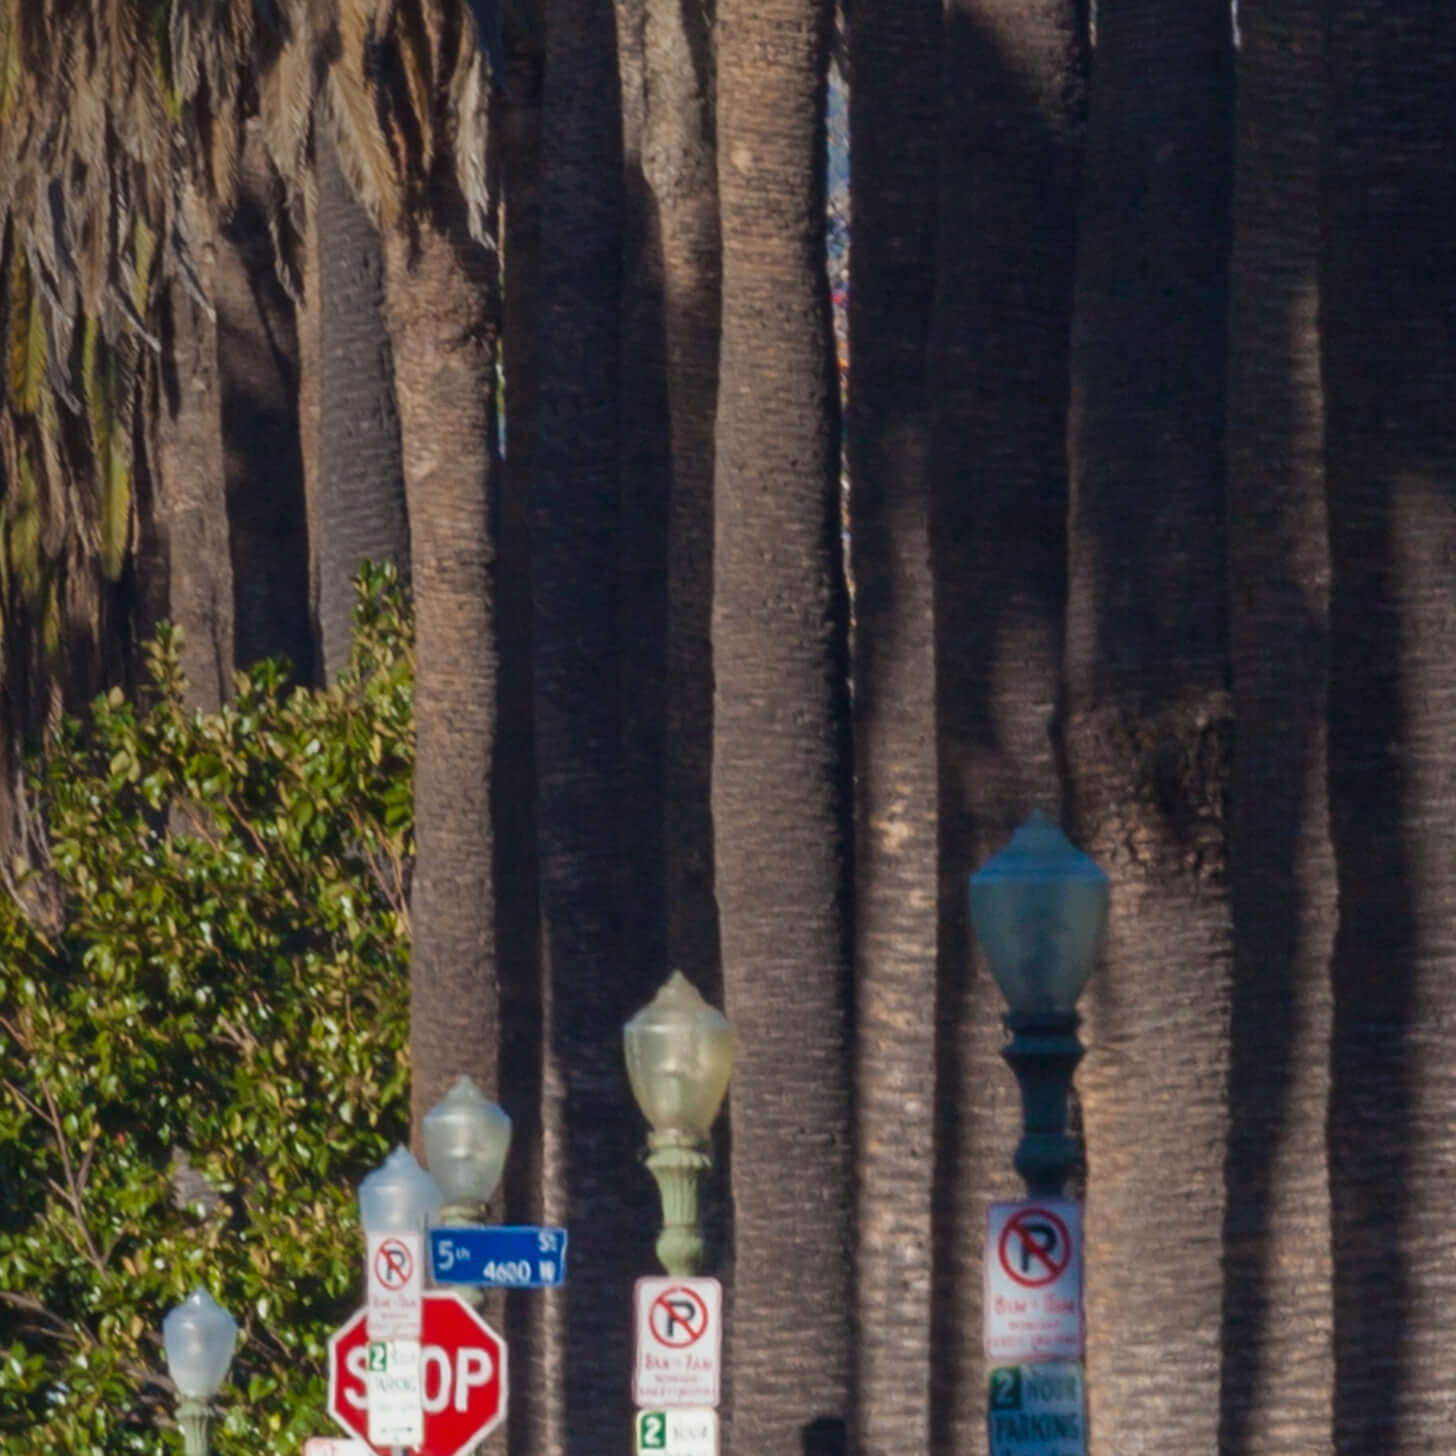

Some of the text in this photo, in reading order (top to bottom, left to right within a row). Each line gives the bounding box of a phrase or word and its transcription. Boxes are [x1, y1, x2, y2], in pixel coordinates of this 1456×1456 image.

[438, 1239, 470, 1271] 5th
[372, 1346, 385, 1370] 2
[344, 1346, 494, 1413] SOP
[996, 1371, 1015, 1402] 2
[644, 1416, 663, 1445] 2
